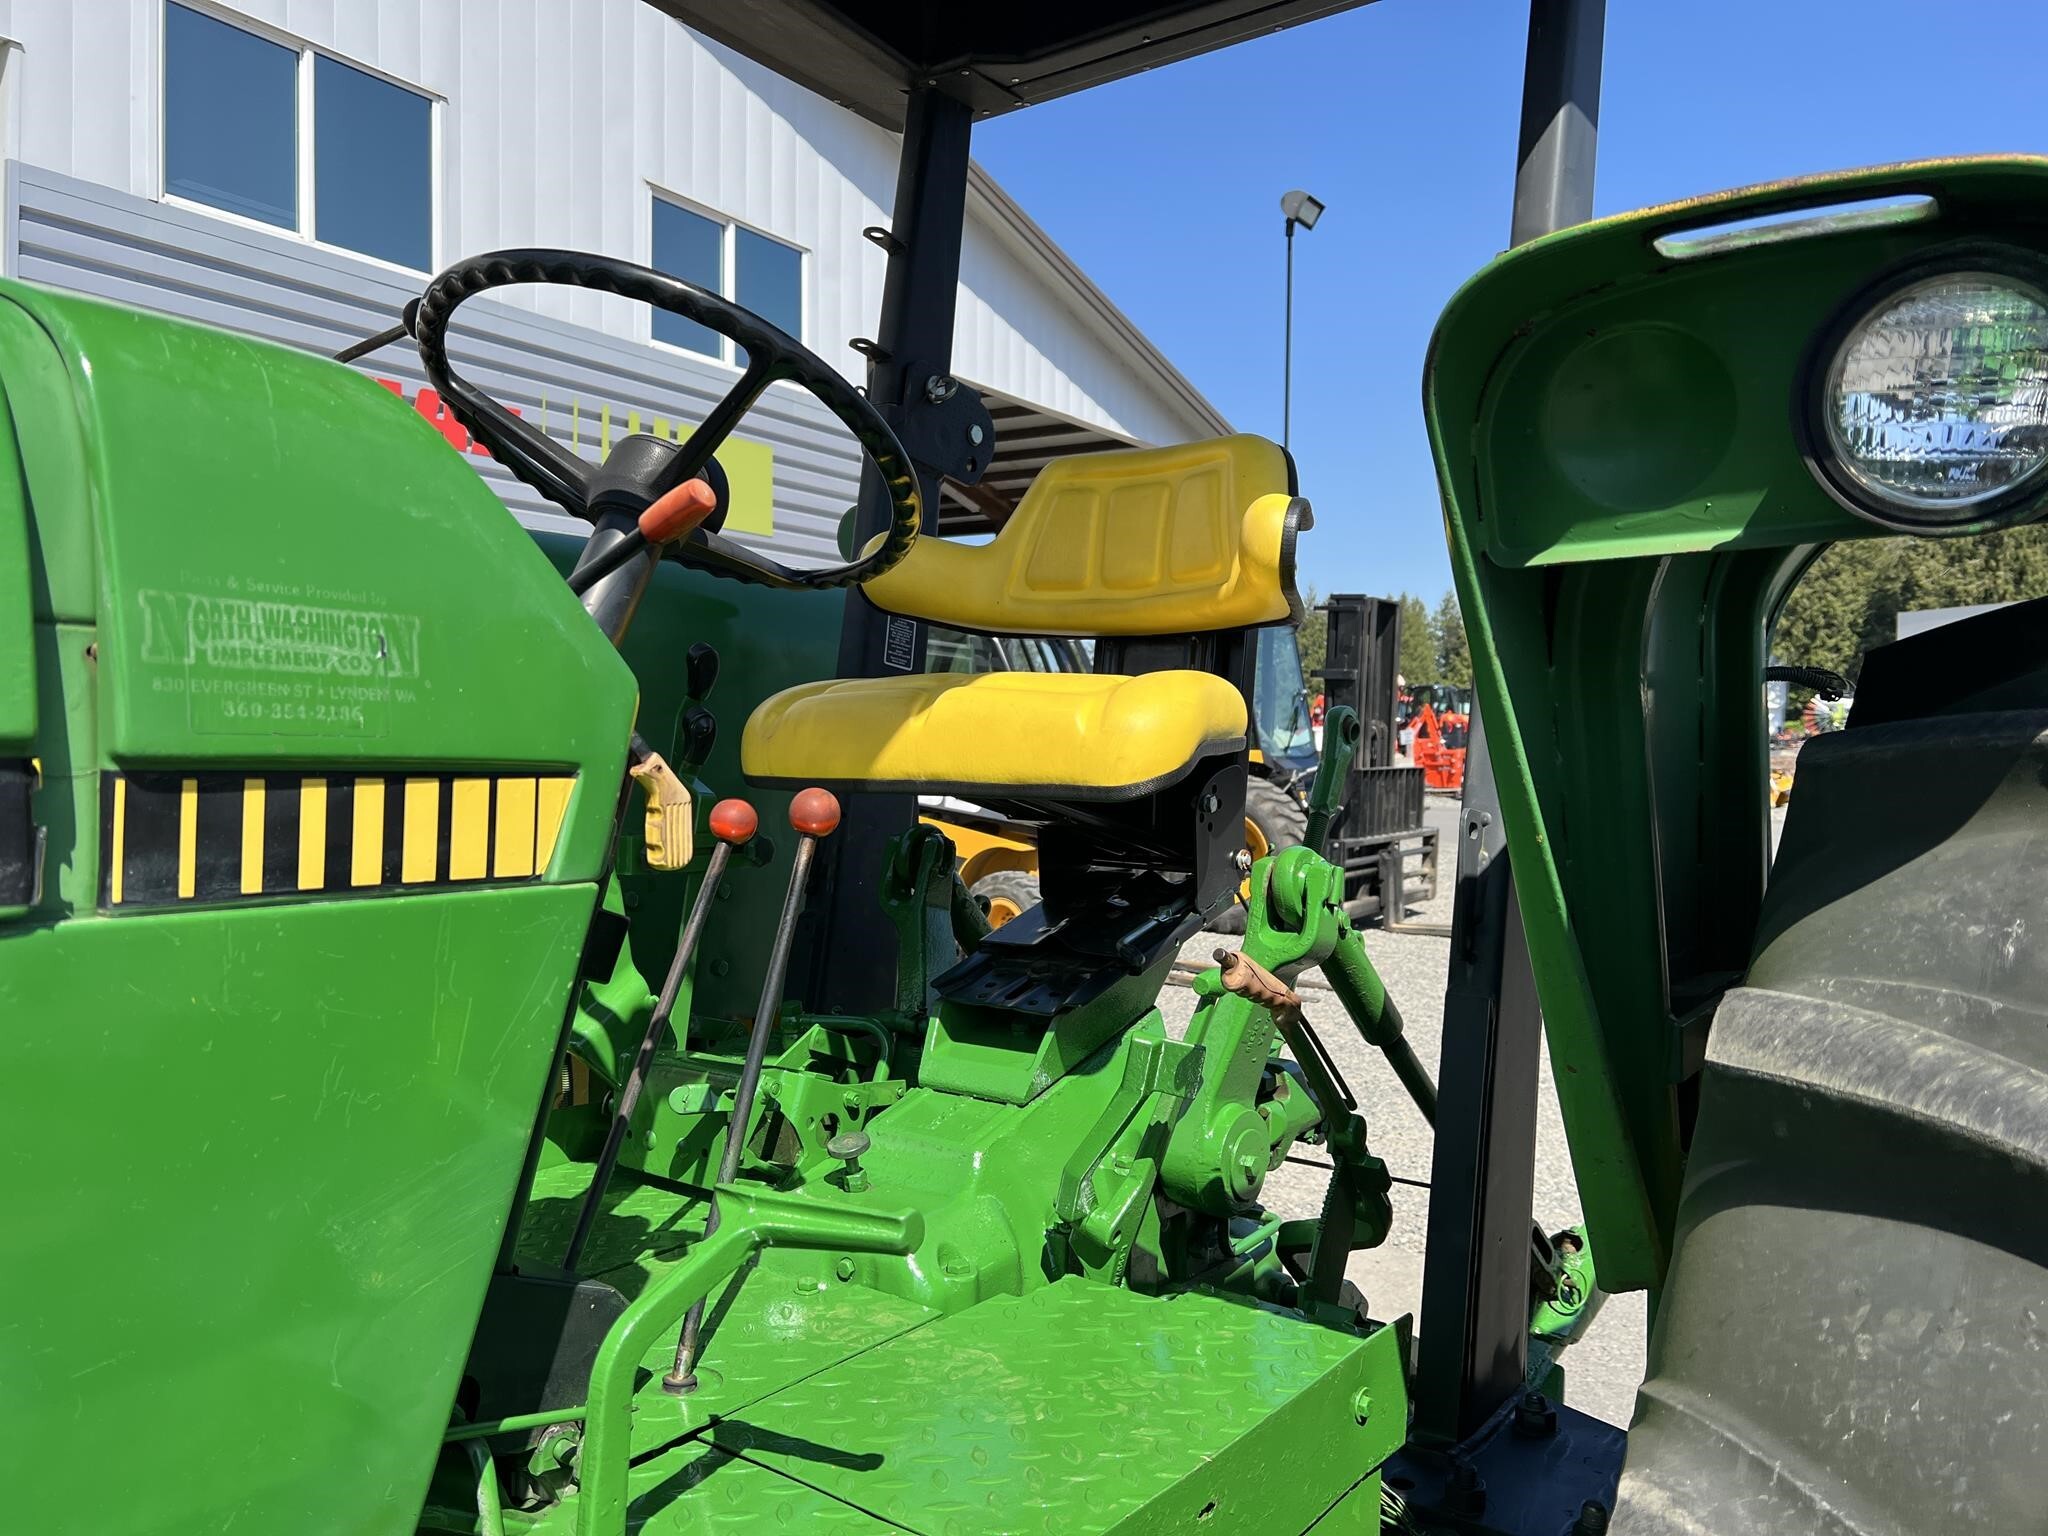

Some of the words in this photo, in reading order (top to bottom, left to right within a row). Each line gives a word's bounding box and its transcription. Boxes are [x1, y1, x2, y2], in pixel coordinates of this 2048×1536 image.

[247, 577, 301, 597] Service
[191, 679, 290, 697] EVERGREEN
[294, 684, 312, 699] ST
